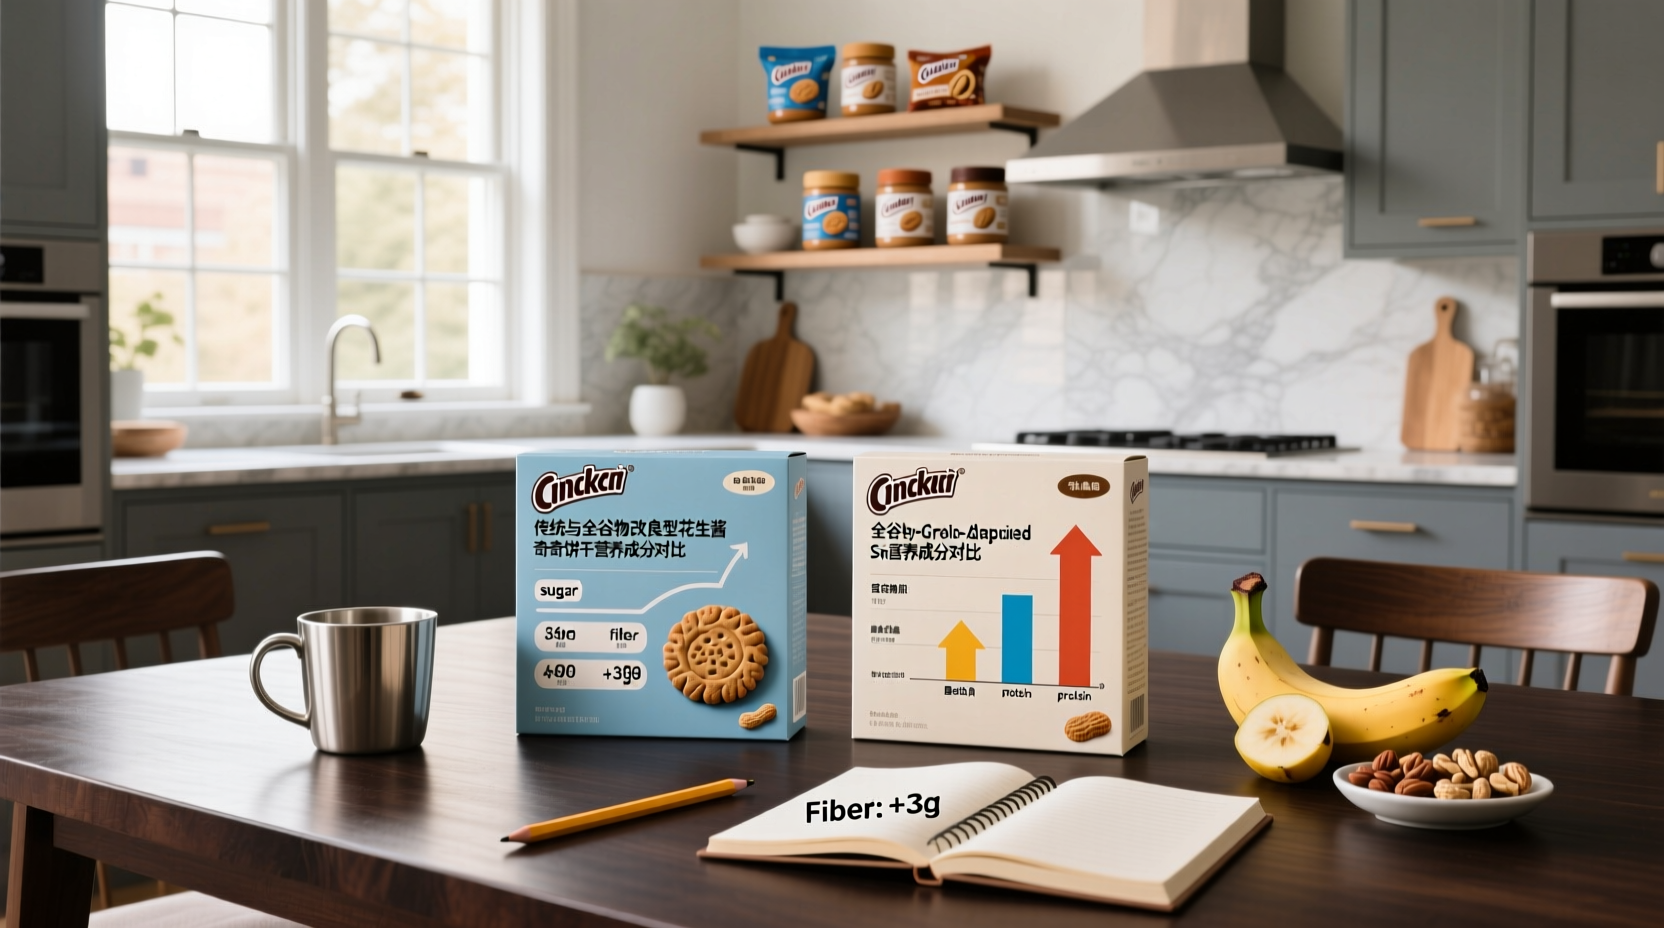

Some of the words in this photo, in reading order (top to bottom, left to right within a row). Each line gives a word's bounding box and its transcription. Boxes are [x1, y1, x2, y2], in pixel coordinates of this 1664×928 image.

[540, 586, 579, 600] sugar
[806, 799, 883, 824] Fiber:
[889, 793, 941, 819] +3g
